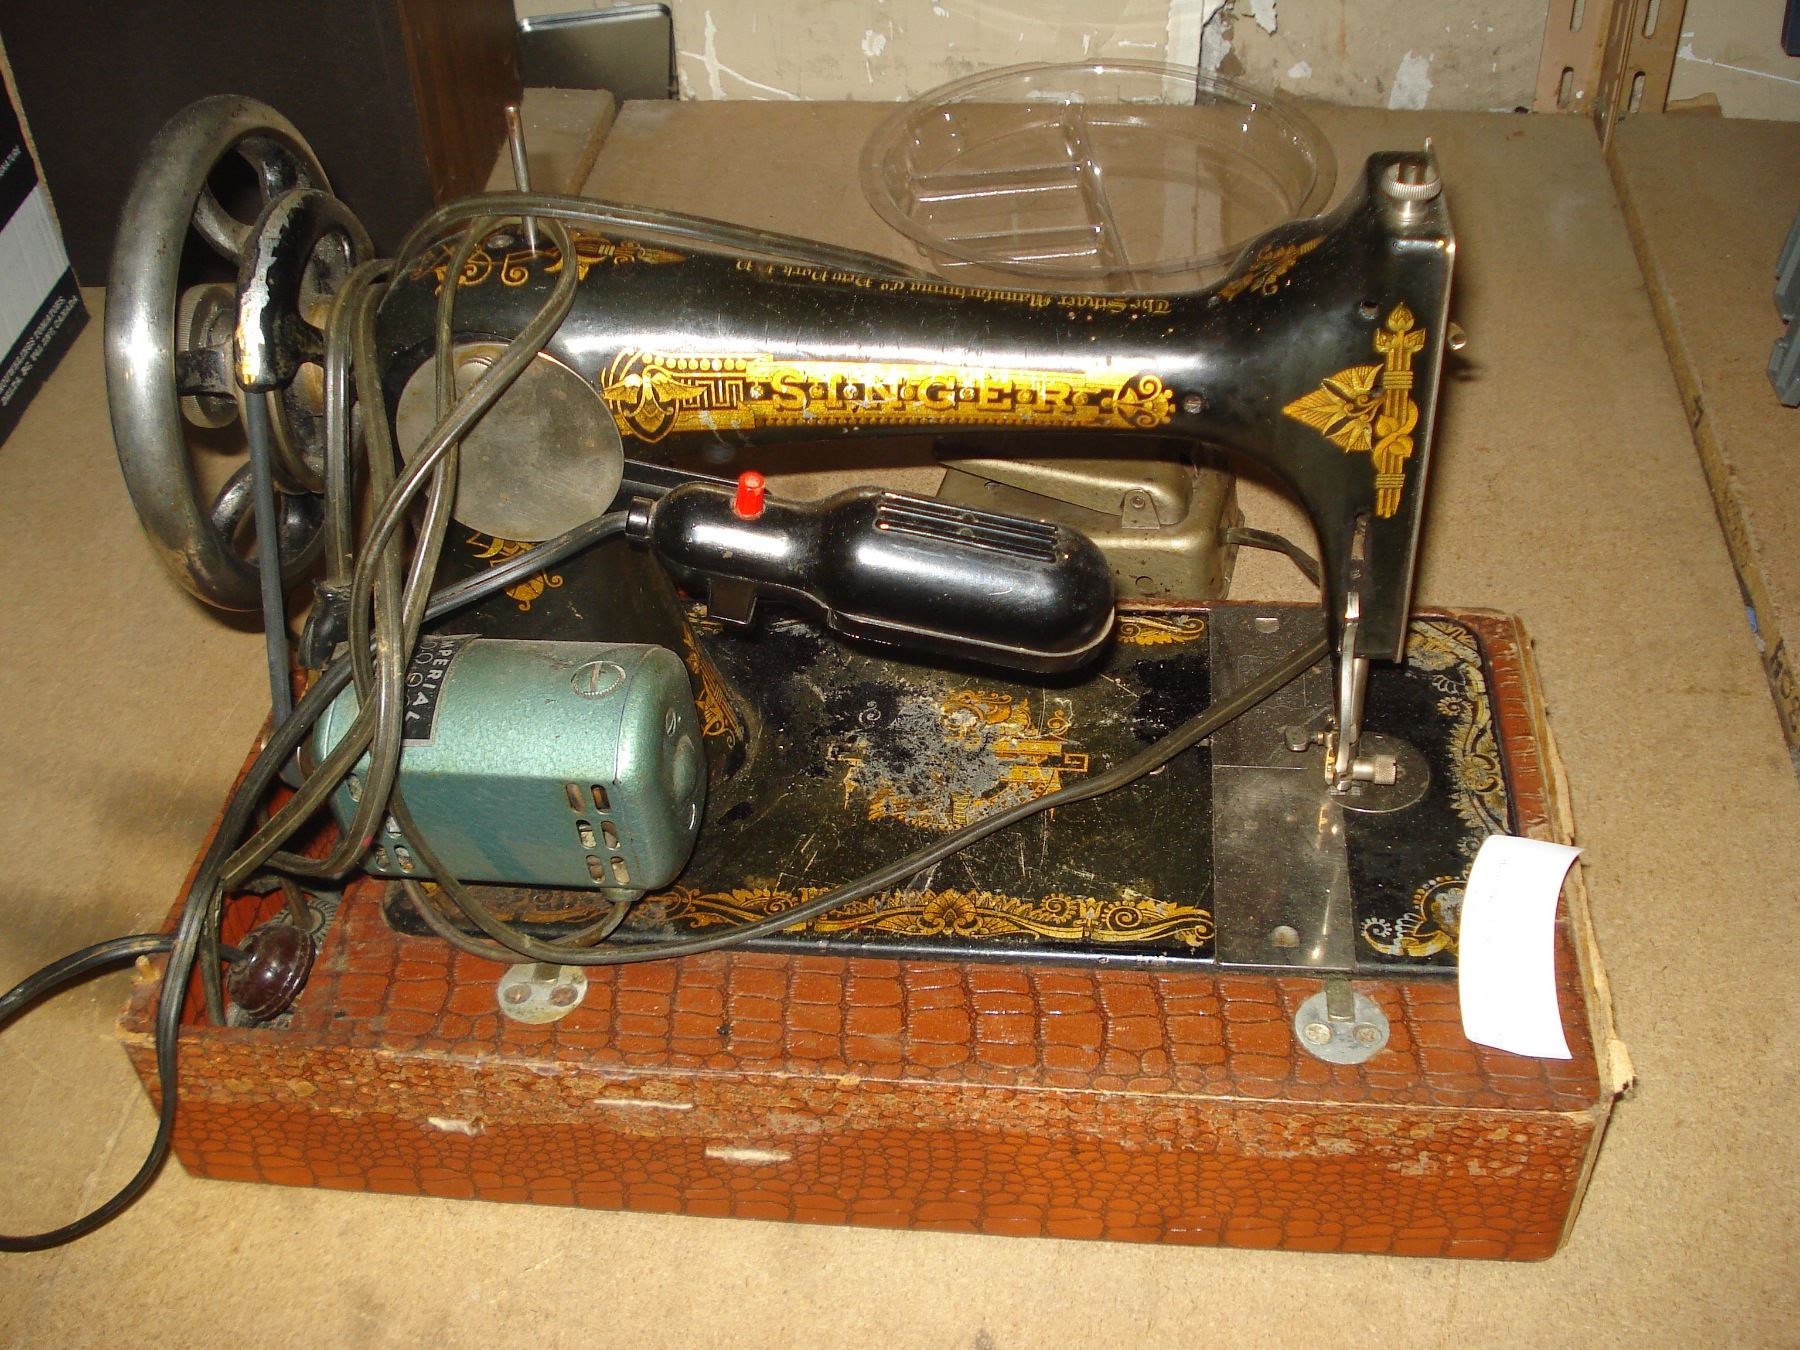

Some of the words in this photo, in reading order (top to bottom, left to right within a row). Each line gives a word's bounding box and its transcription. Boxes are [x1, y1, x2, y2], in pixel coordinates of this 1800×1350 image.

[1058, 295, 1128, 313] Singer
[1129, 297, 1172, 315] The
[769, 367, 1076, 413] SINGER
